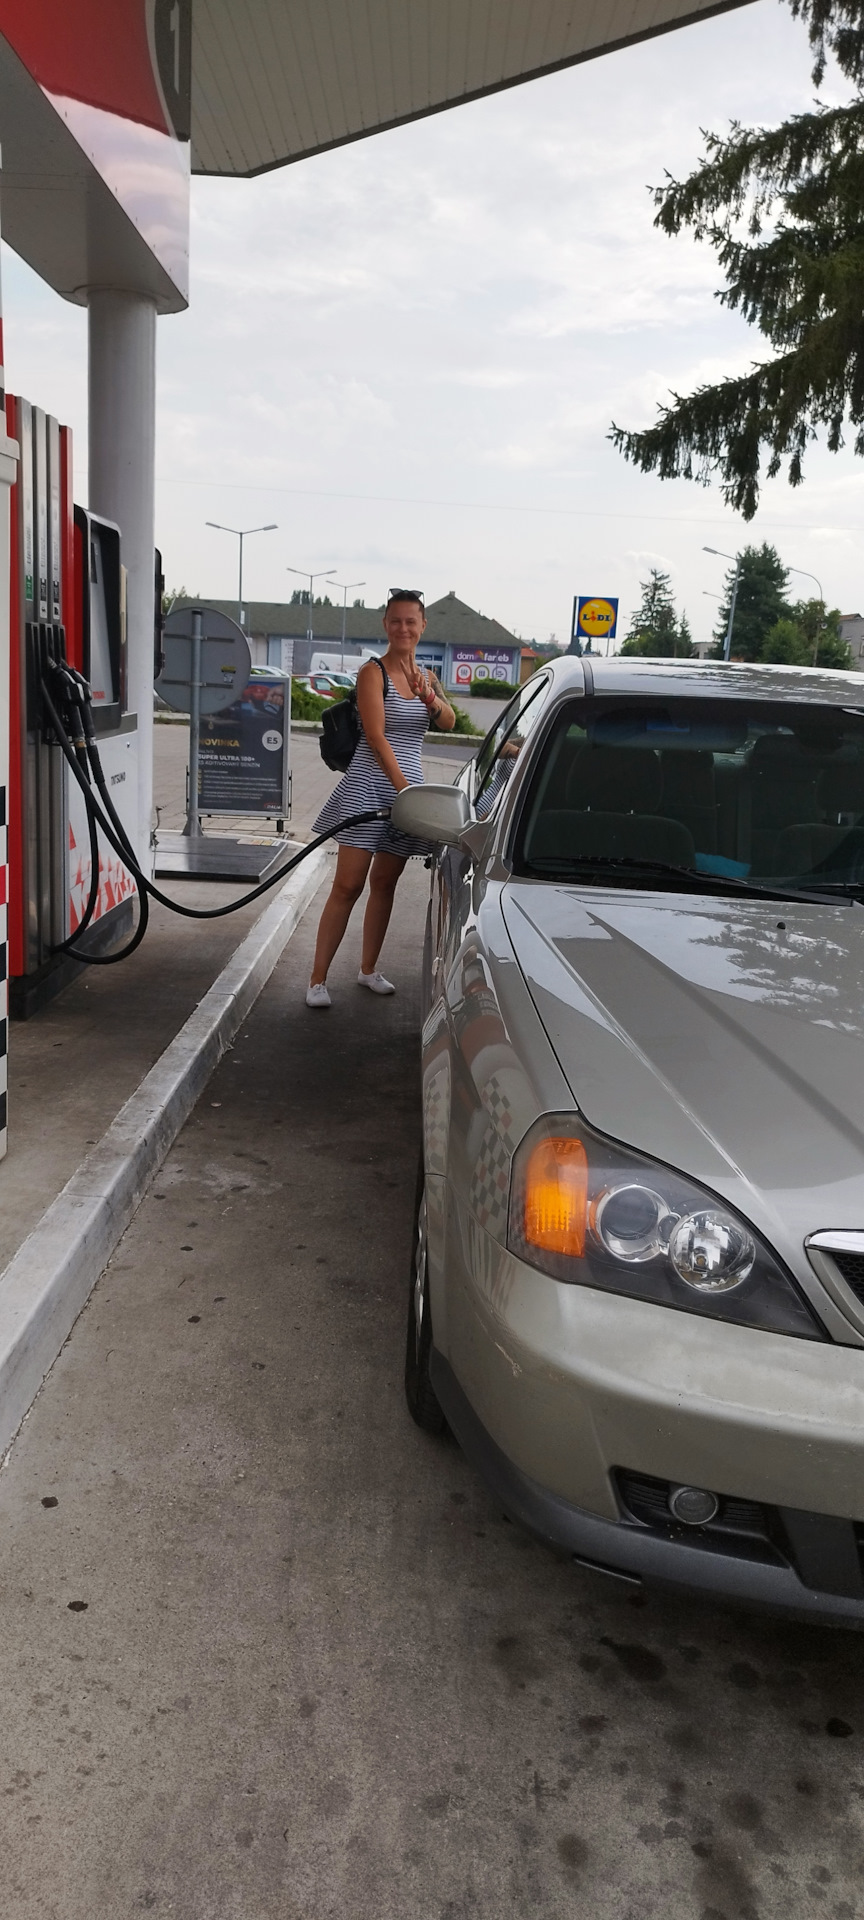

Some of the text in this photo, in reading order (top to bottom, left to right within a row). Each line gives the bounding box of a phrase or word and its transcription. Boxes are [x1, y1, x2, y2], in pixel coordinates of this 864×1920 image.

[456, 651, 510, 662] dom fareb
[199, 738, 239, 746] NOVINKA
